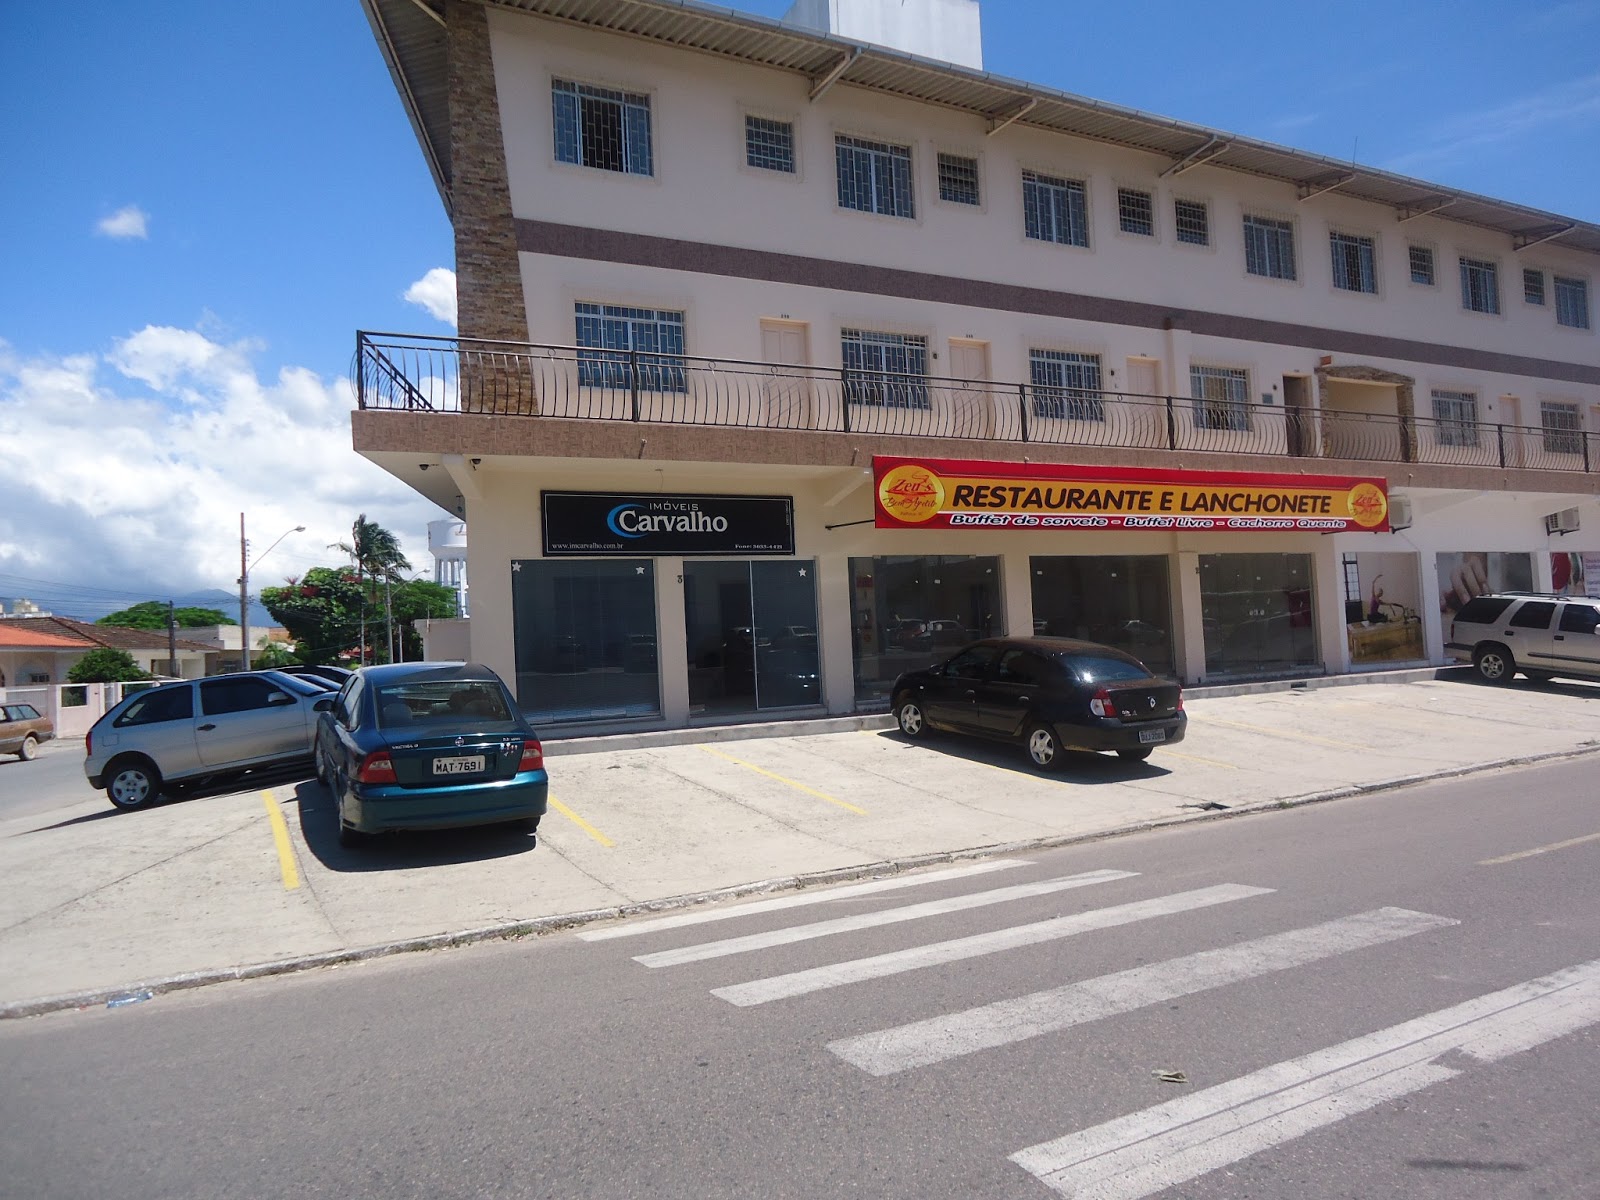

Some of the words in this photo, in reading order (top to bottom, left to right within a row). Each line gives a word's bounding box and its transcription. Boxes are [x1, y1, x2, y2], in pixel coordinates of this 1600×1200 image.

[649, 501, 699, 511] IMÓVEIS
[952, 485, 1153, 511] RESTAURANTE
[1159, 491, 1174, 511] E
[1180, 492, 1332, 513] LANCHONETE
[618, 510, 728, 532] Carvalho
[951, 514, 1010, 525] Buffet
[1014, 515, 1039, 526] de
[1042, 516, 1107, 526] sorvete
[1125, 517, 1174, 527] Buffet
[1176, 517, 1213, 528] Livre
[1228, 518, 1294, 528] Cachorro
[1297, 519, 1346, 529] Quente
[677, 574, 683, 584] 3
